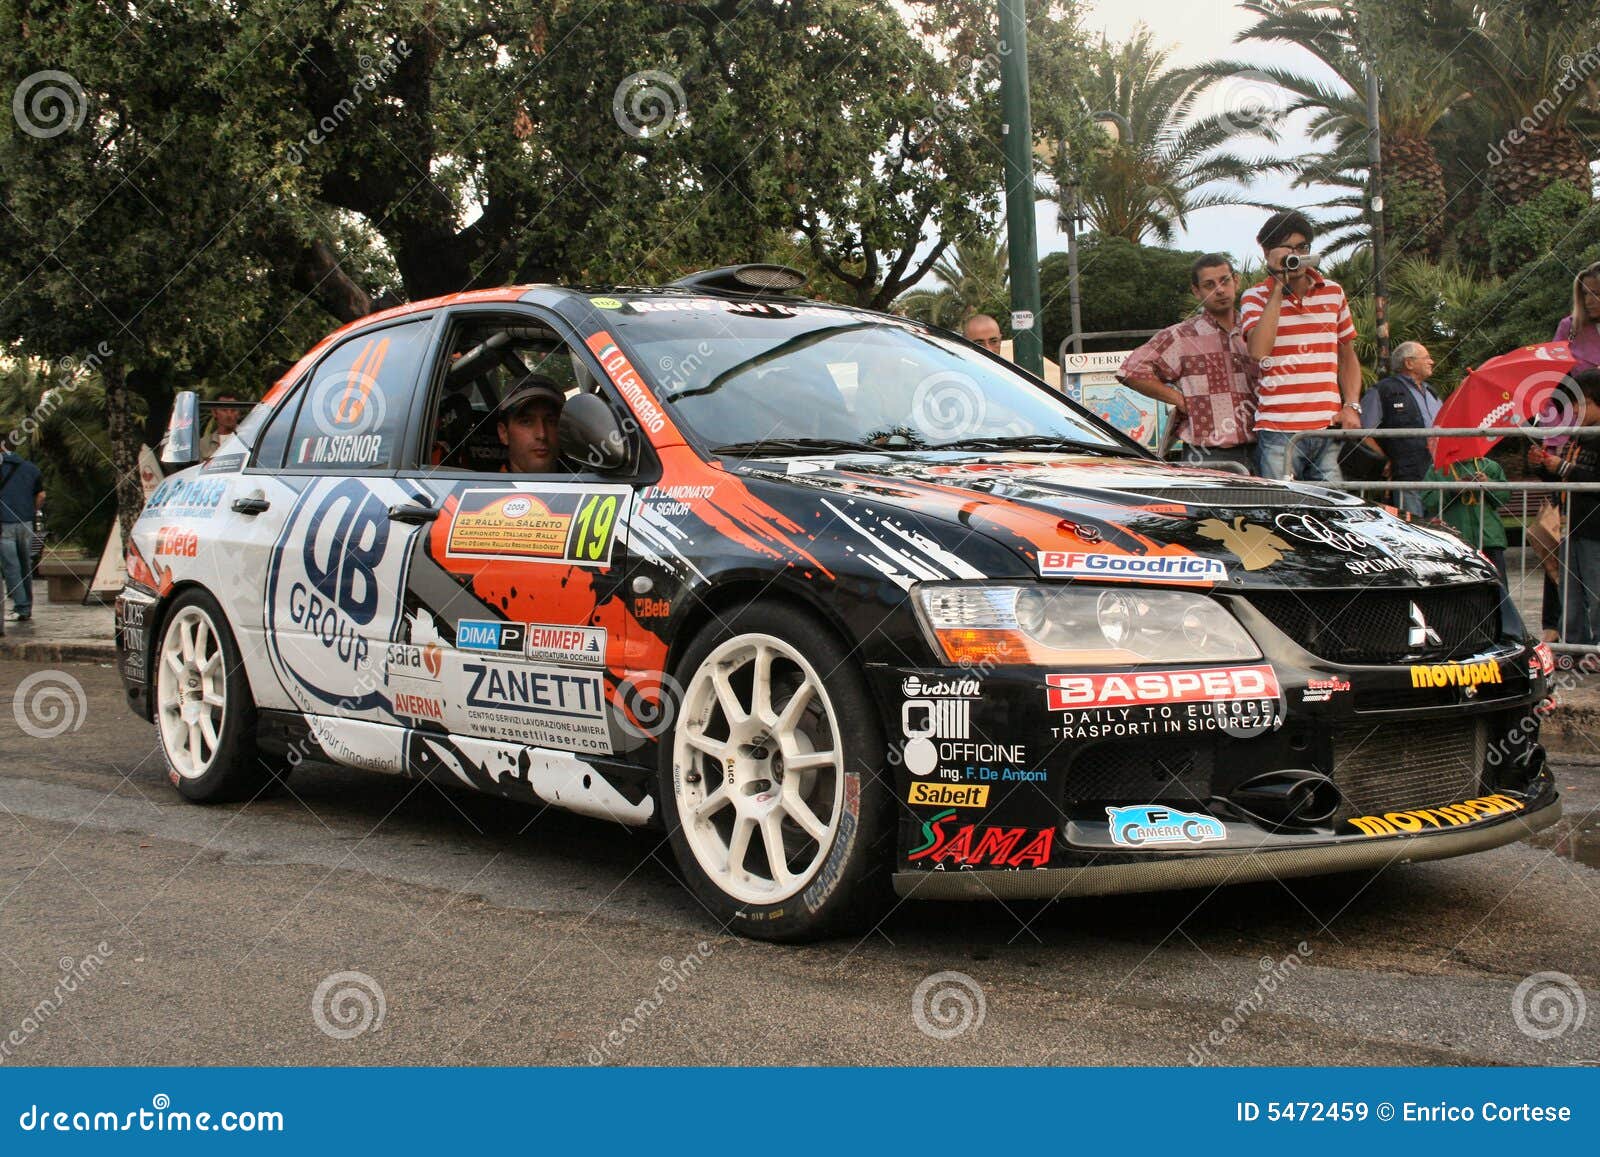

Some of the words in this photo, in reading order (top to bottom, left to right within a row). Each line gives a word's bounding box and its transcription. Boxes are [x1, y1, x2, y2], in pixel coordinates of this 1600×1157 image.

[606, 356, 625, 376] D.
[616, 369, 665, 433] Lamonato
[660, 486, 714, 499] LAMONATO
[656, 502, 691, 516] SIGNOR
[474, 519, 503, 527] RALLY
[516, 520, 562, 529] SALENTO
[575, 494, 617, 560] 19
[1042, 552, 1222, 574] BFGoodrich
[644, 600, 670, 617] Beta
[289, 582, 369, 671] GROUP
[458, 626, 497, 645] DIMA
[501, 628, 520, 646] P
[532, 628, 584, 651] EMMEPI
[387, 644, 421, 668] sara
[569, 653, 600, 663] OCCHIALI
[463, 663, 602, 711] ZANETTI
[1060, 669, 1265, 704] BASPED
[394, 693, 443, 720] AVERNA
[1063, 709, 1130, 725] DAILY
[1146, 706, 1172, 719] TO
[1188, 700, 1270, 717] EUROPE
[468, 710, 495, 722] CENTRO
[495, 712, 522, 725] SERVIZI
[521, 718, 572, 733] LAVORAZIONE
[571, 723, 606, 737] LAMIERA
[1051, 722, 1157, 739] TRASPORTI
[1164, 719, 1181, 733] IN
[1187, 715, 1282, 731] SICUREZZA
[940, 743, 1026, 764] OFFICINE
[940, 766, 963, 782] ing.
[966, 767, 977, 780] F.
[980, 768, 998, 780] De
[1002, 768, 1047, 781] Antoni
[914, 784, 983, 805] Sabelt
[1146, 811, 1168, 823] F
[908, 808, 1056, 867] SAMA
